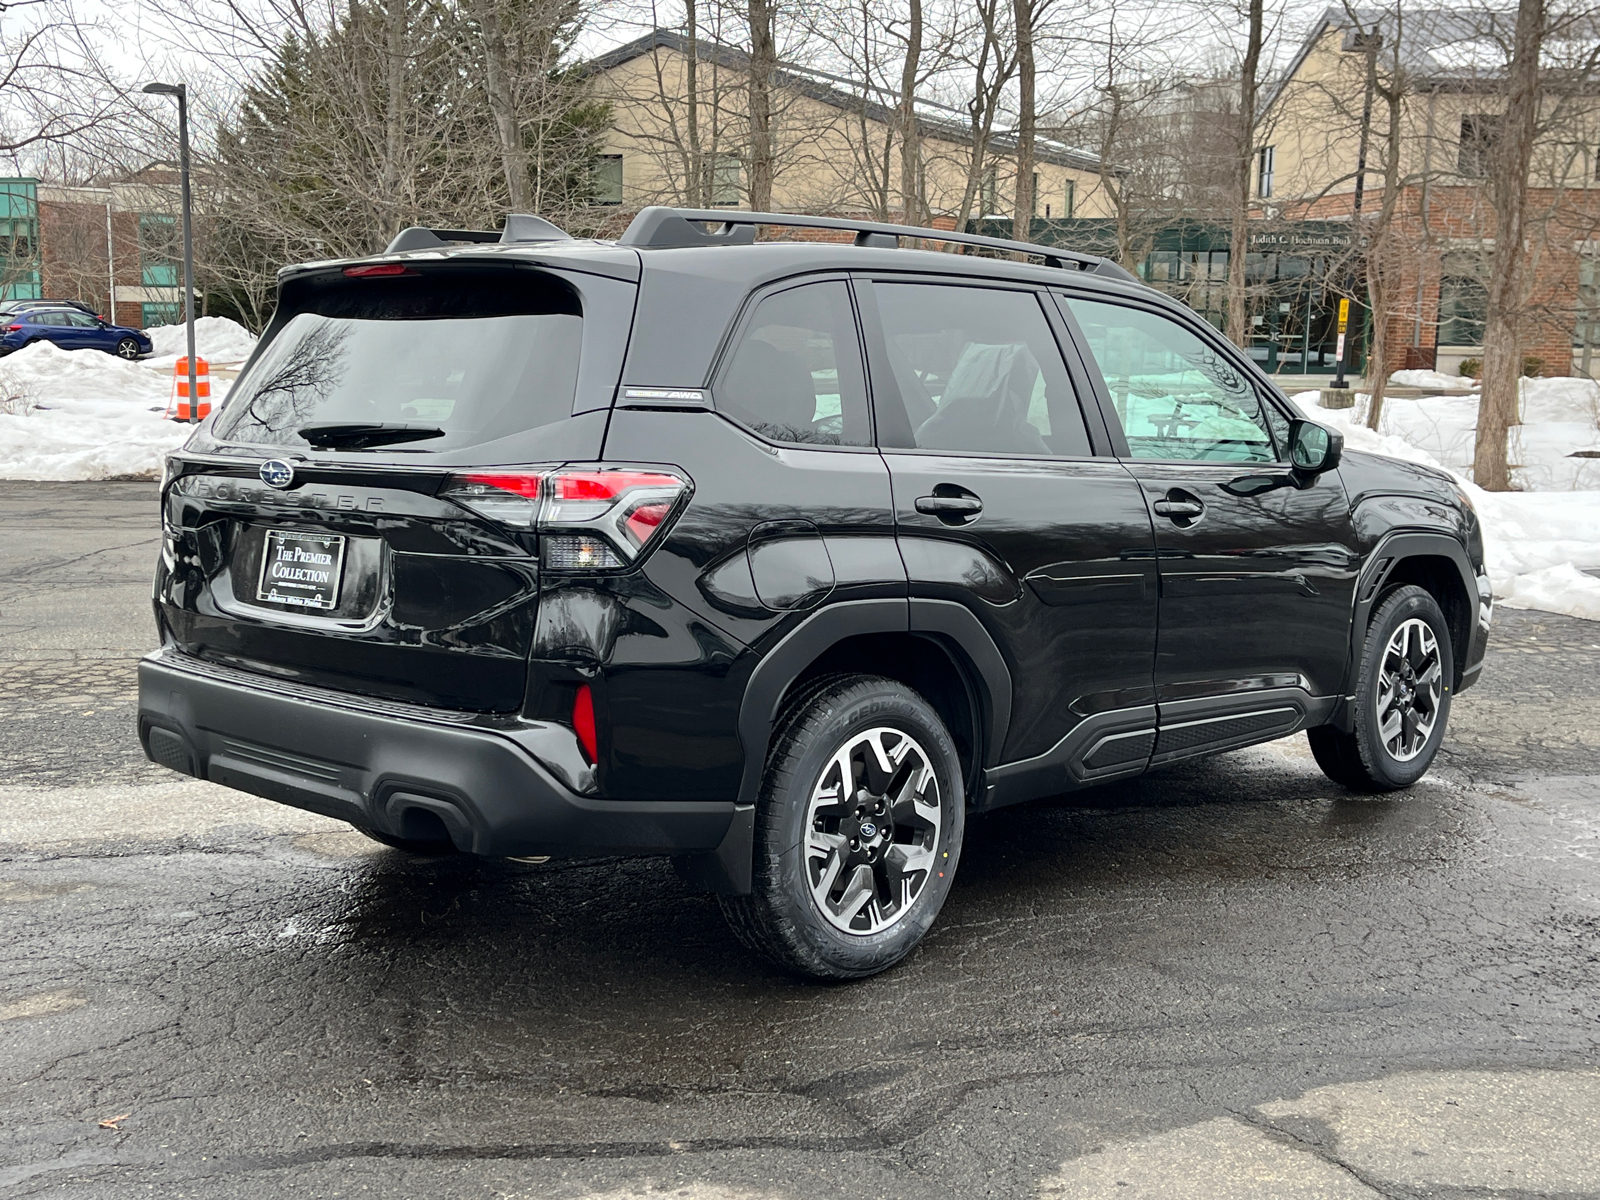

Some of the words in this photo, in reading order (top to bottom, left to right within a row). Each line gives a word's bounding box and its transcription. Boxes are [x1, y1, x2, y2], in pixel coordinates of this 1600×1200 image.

[1251, 234, 1277, 246] Judith
[667, 391, 702, 400] AWD
[198, 483, 386, 512] FORESTER
[276, 545, 293, 561] THE
[294, 547, 332, 565] PREMIER
[272, 562, 329, 582] COLLECTION
